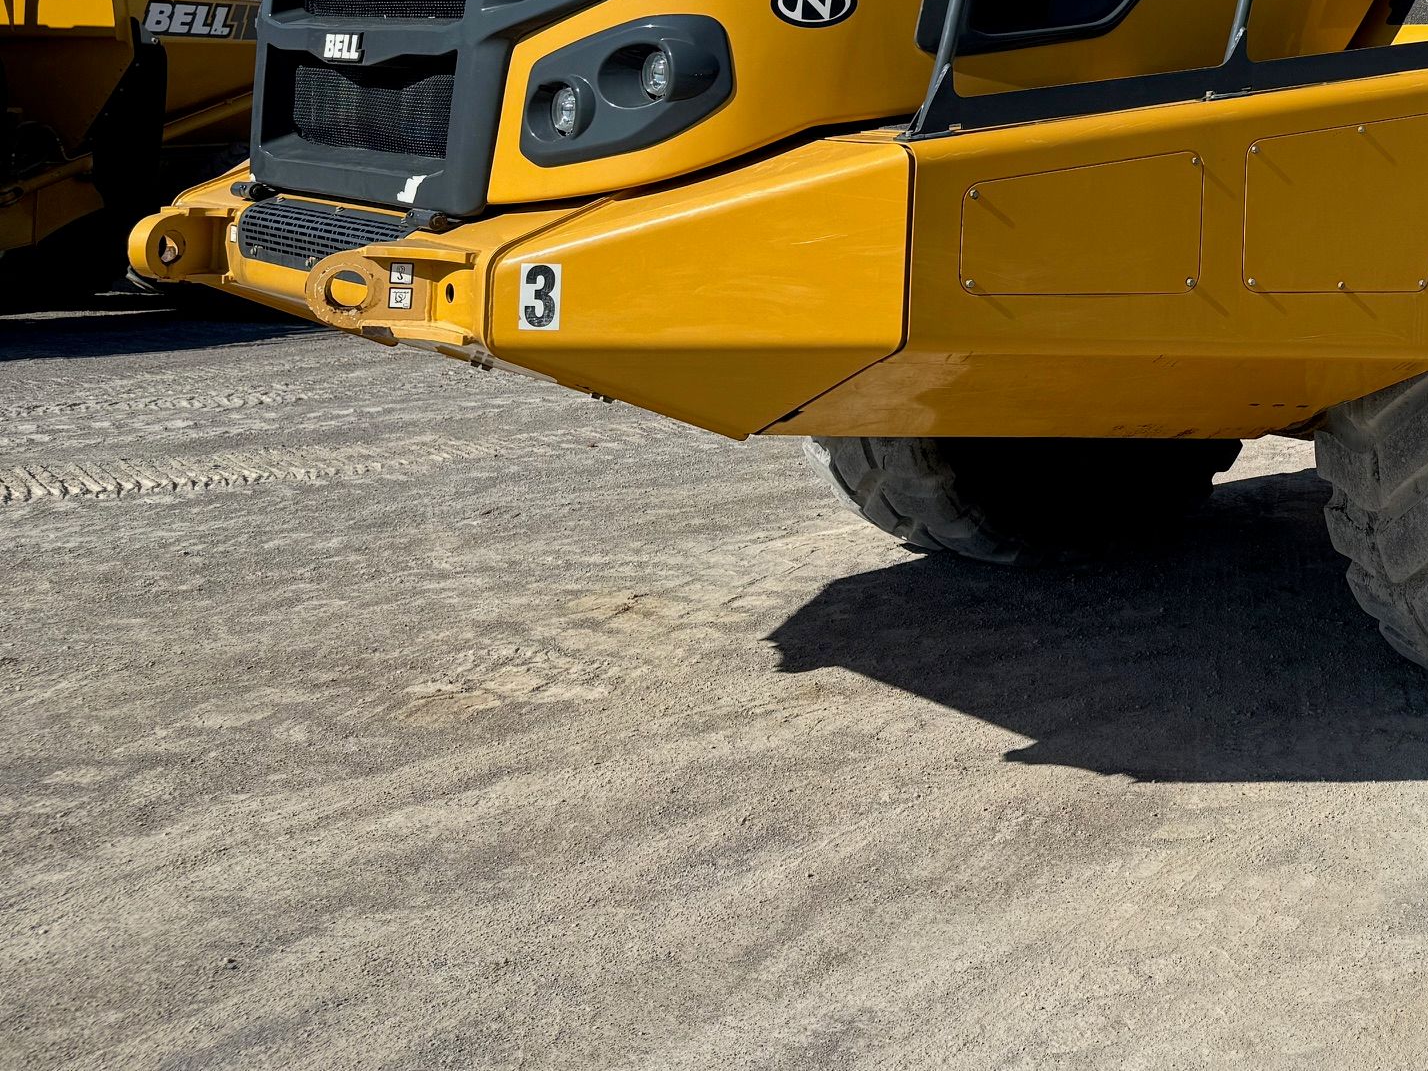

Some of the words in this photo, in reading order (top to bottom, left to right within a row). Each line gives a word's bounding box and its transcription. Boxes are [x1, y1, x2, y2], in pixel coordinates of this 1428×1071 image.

[144, 2, 231, 36] BELL
[323, 33, 360, 59] BELL
[524, 264, 556, 328] 3
